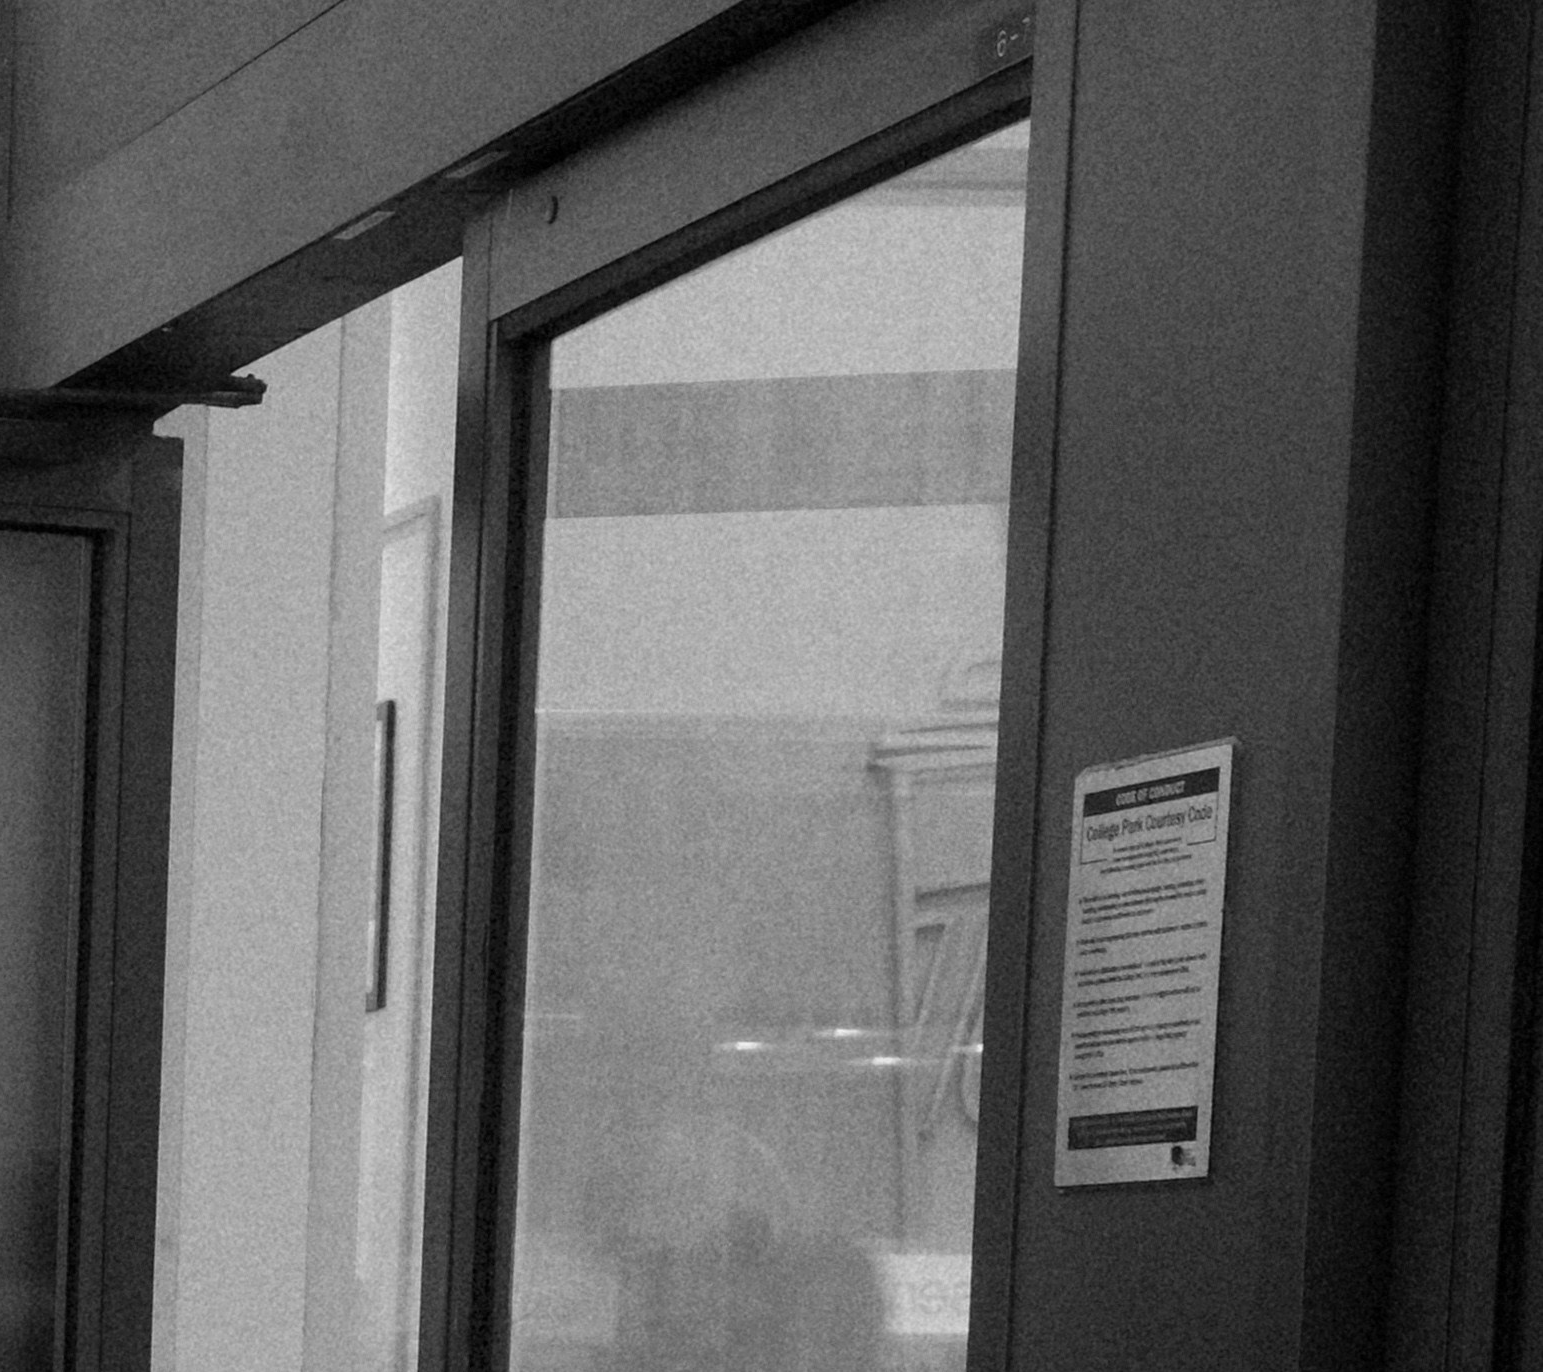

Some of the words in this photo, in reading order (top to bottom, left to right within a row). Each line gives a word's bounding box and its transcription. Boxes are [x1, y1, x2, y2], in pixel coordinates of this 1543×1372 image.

[1086, 824, 1120, 841] College
[1122, 818, 1144, 834] Park
[1145, 812, 1186, 831] Courtesy
[1188, 804, 1213, 822] Code
